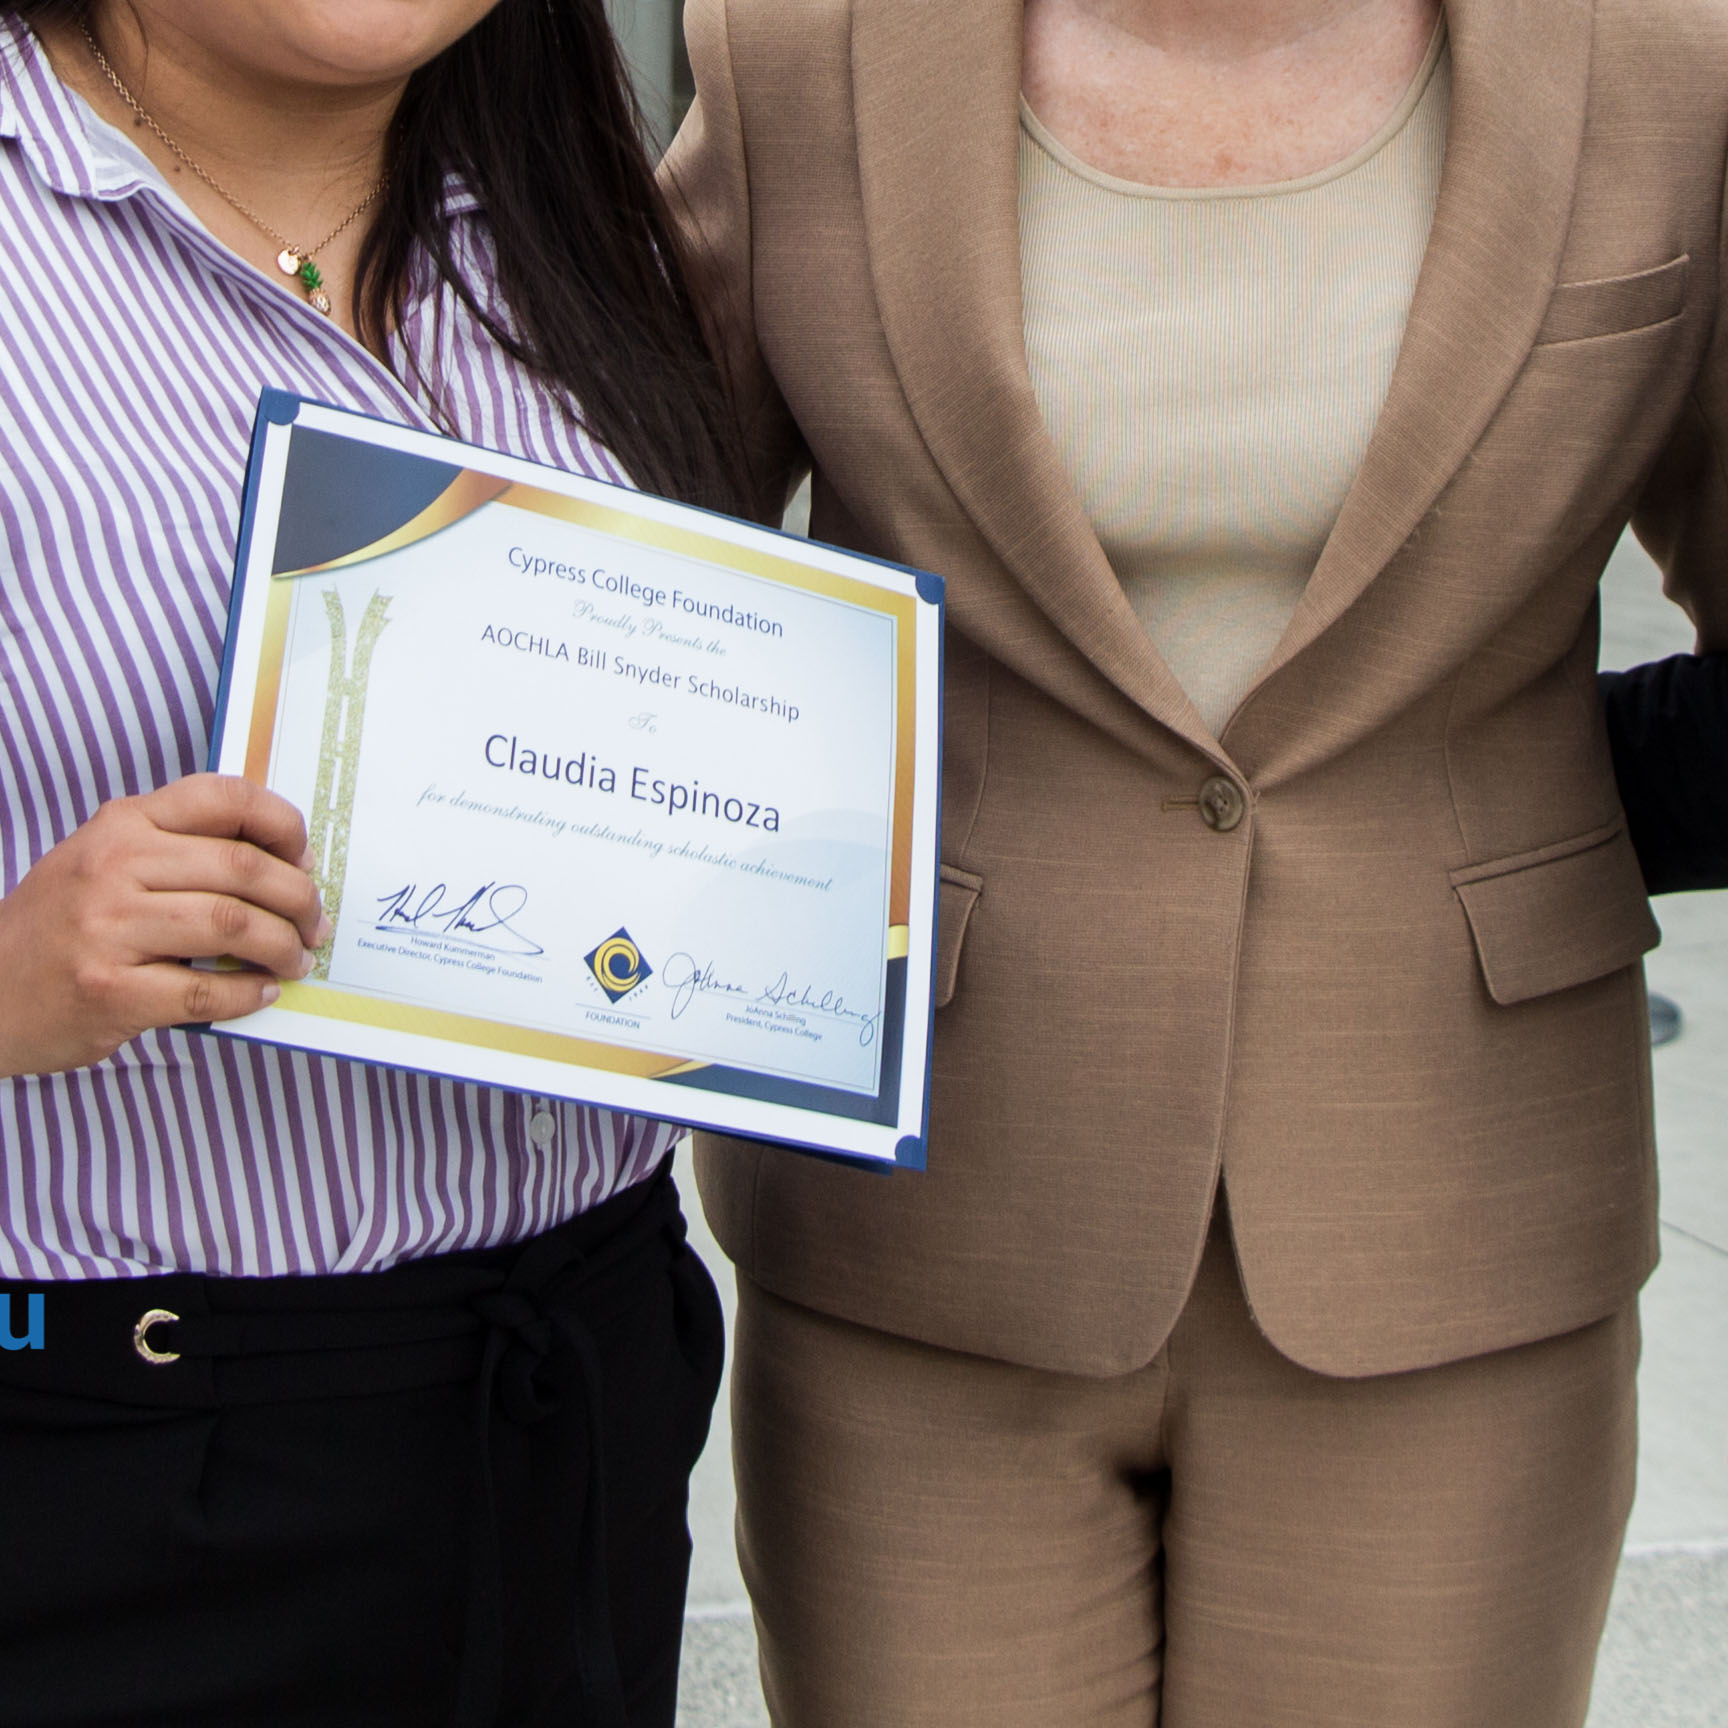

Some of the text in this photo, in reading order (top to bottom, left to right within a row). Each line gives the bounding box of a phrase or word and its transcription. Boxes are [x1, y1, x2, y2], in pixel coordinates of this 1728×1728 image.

[507, 546, 784, 638] Cypress College Foundation
[572, 599, 728, 657] Proudly Presents the
[480, 624, 801, 724] AOCHLA Bill Snyder Scholarship
[627, 712, 659, 734] To
[484, 733, 782, 834] Claudia Espinoza
[415, 783, 834, 893] for demonstrating outstanding scholastic achievement
[357, 937, 397, 954] Executive
[433, 953, 465, 970] Cypress
[465, 960, 496, 976] College
[497, 965, 543, 984] Foundation
[410, 935, 496, 962] Howard Kummerman
[585, 1010, 641, 1029] FOUNDATION
[764, 1020, 793, 1034] Cypress
[795, 1027, 823, 1041] College
